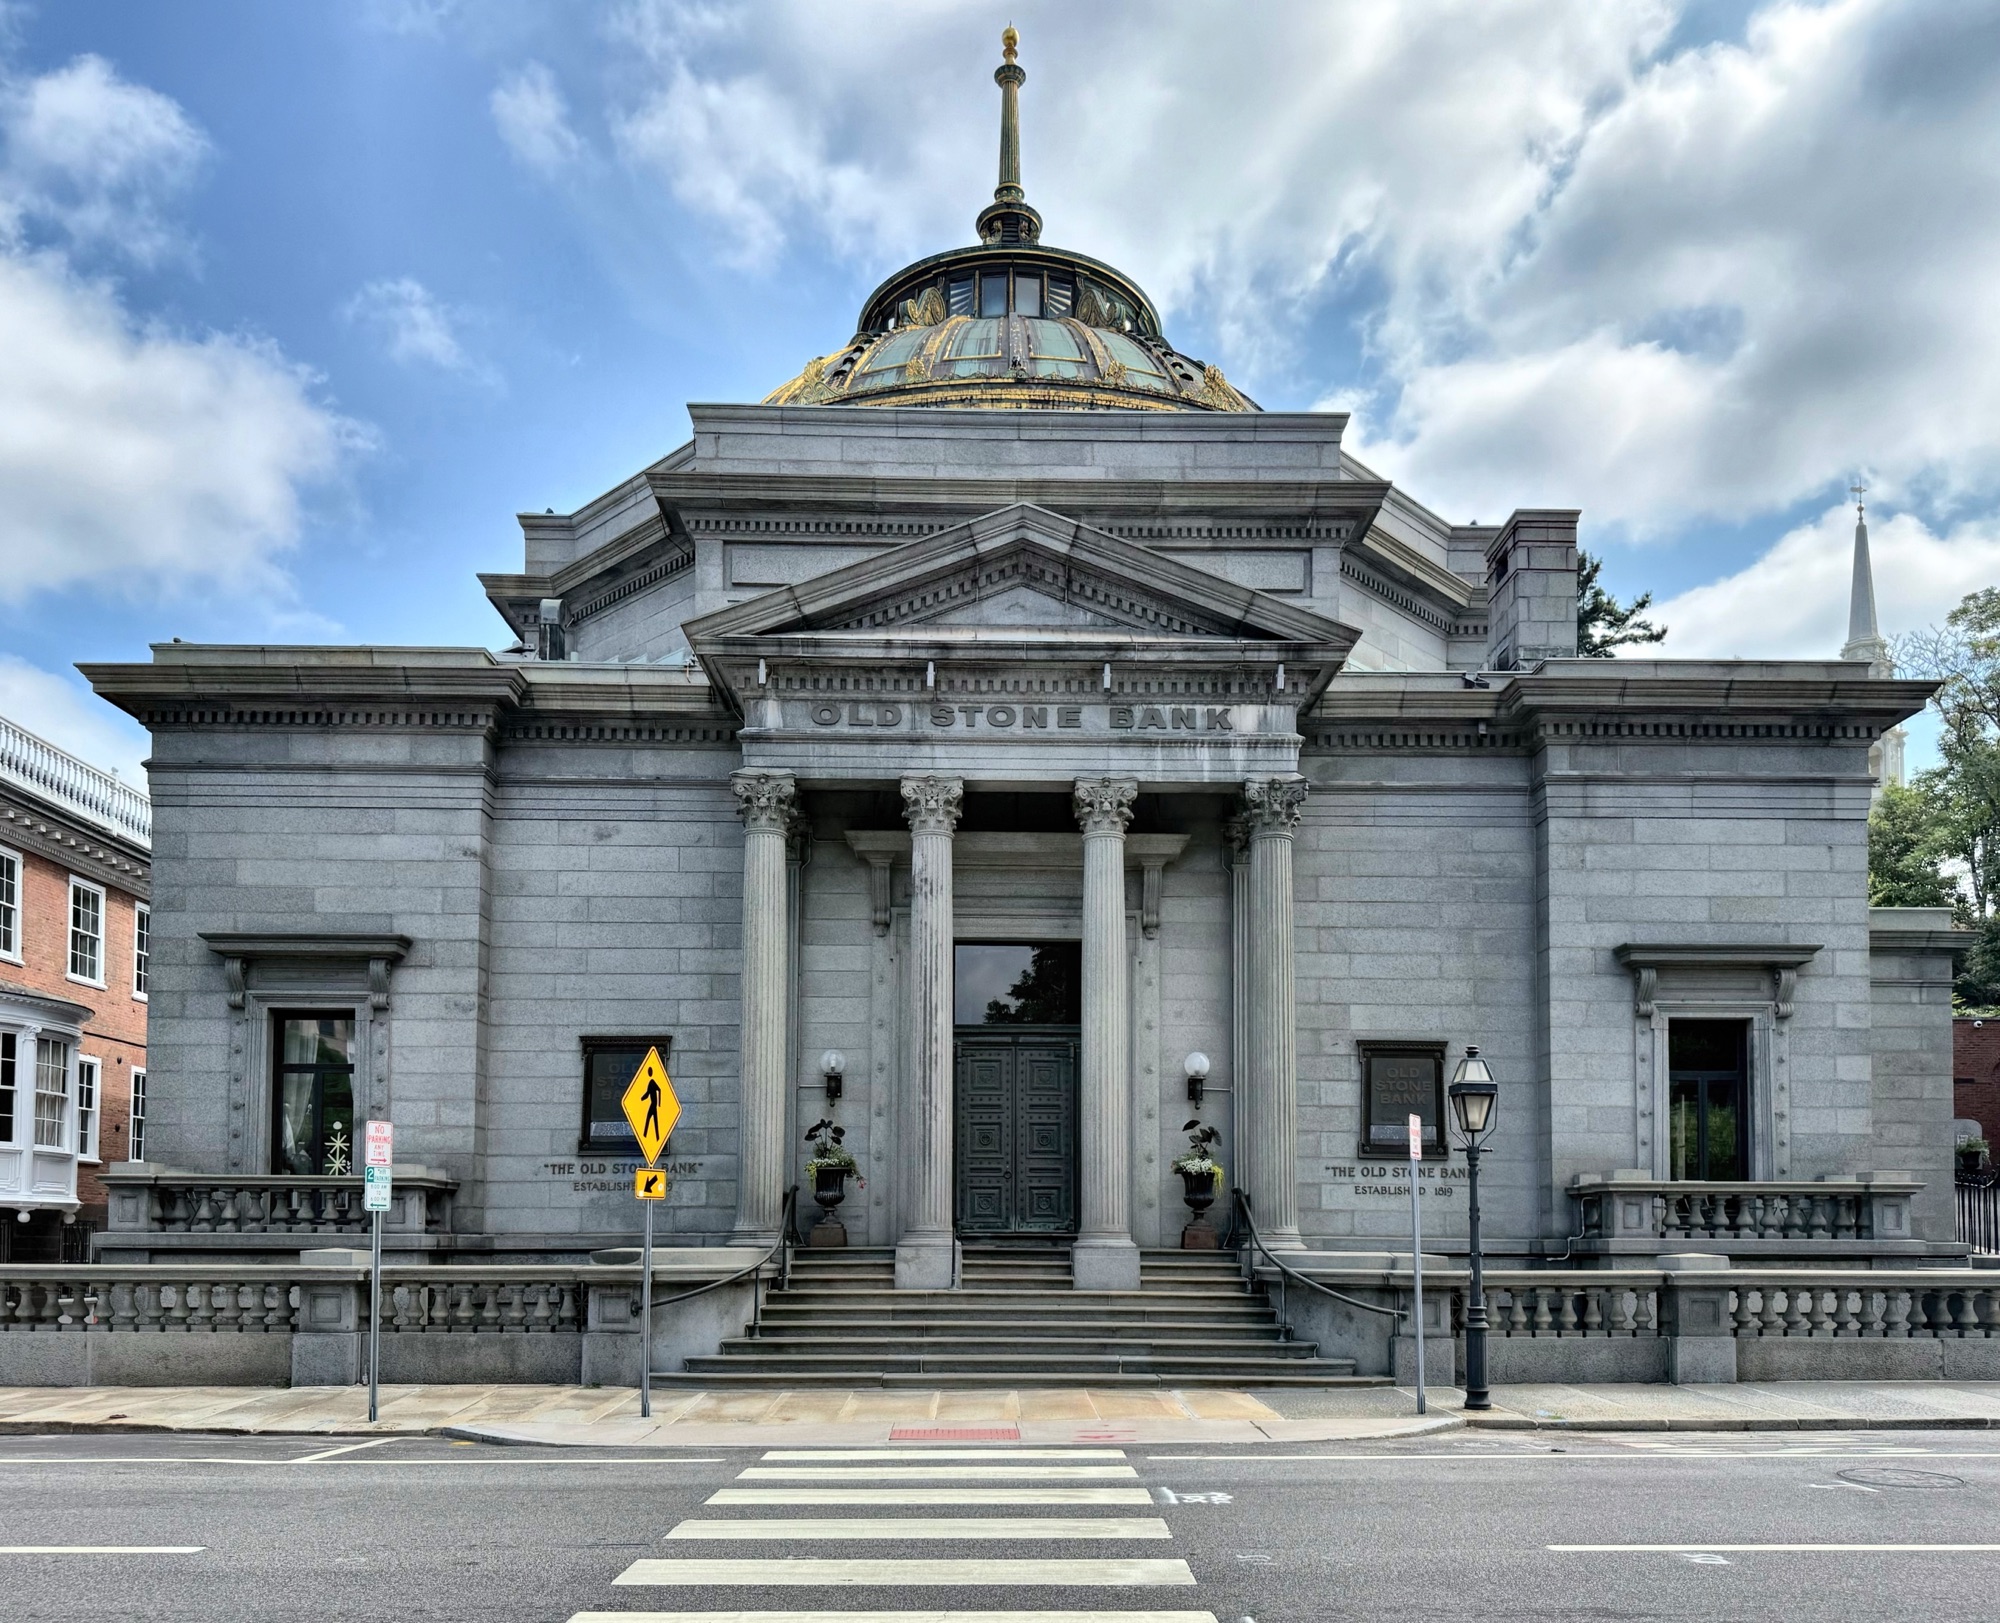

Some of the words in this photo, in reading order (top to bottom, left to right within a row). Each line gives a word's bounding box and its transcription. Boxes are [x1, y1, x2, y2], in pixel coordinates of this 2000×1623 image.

[811, 704, 903, 727] OLD
[930, 705, 1082, 728] STONE
[1109, 706, 1233, 730] BANK
[1386, 1067, 1420, 1078] OLD
[1375, 1080, 1432, 1092] STONE
[1380, 1093, 1427, 1105] BANK
[375, 1125, 385, 1135] NO
[368, 1134, 392, 1144] PARKING
[367, 1168, 374, 1180] 2
[580, 1163, 606, 1175] OLD
[1360, 1167, 1387, 1178] OLD
[1392, 1167, 1435, 1179] STNE
[1354, 1185, 1426, 1196] ESTABLISHD
[1434, 1187, 1453, 1198] 1819
